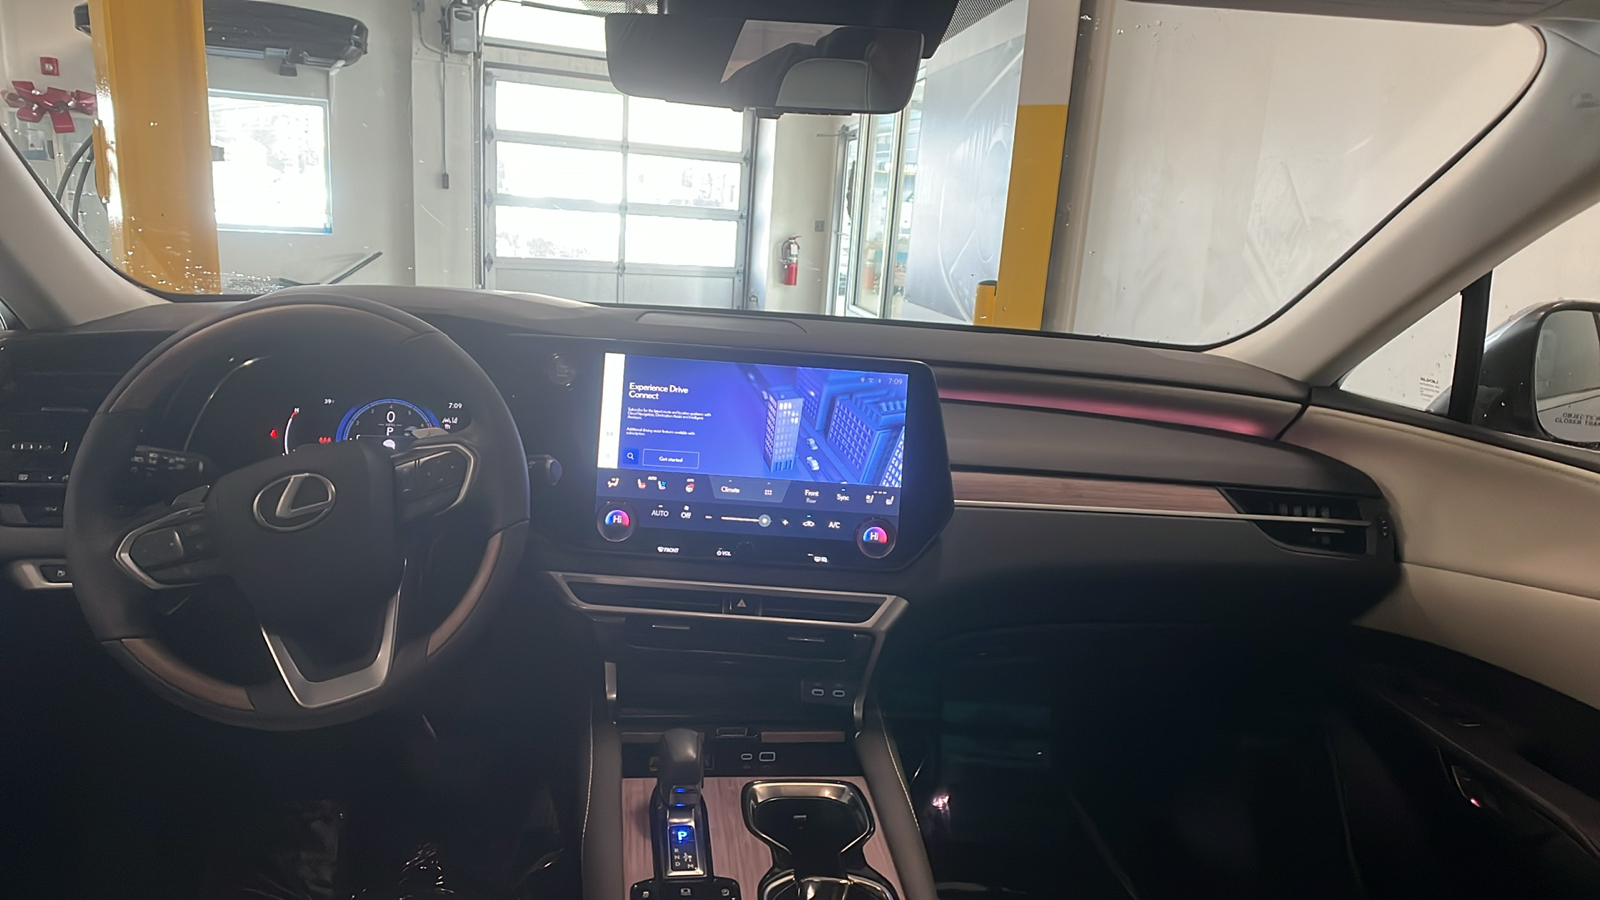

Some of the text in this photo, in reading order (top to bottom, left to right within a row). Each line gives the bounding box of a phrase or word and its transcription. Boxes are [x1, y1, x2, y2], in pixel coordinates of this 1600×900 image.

[629, 382, 689, 394] Experience Drive
[628, 390, 660, 400] Connect
[386, 426, 394, 436] P
[720, 486, 740, 494] Climate
[836, 494, 850, 502] Sync
[612, 514, 622, 524] Hi
[870, 532, 880, 540] Hi
[678, 831, 688, 841] P
